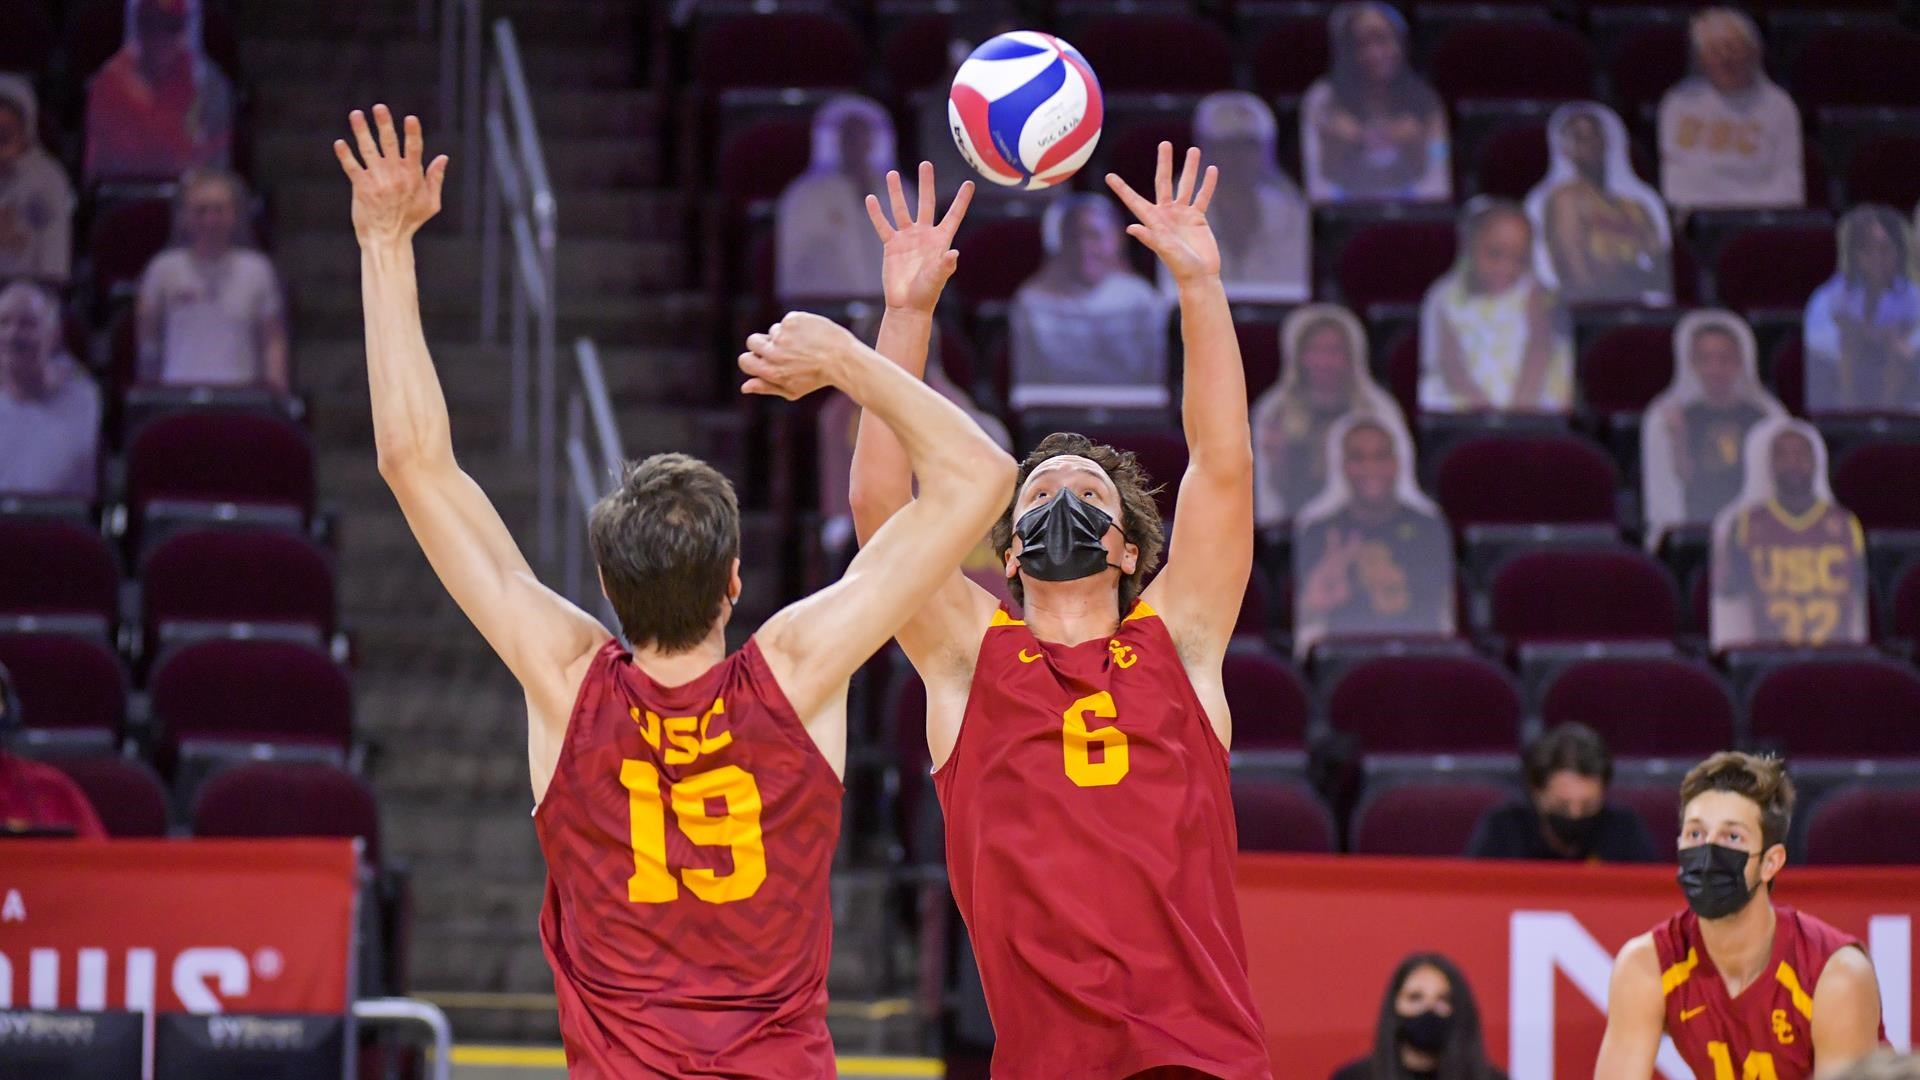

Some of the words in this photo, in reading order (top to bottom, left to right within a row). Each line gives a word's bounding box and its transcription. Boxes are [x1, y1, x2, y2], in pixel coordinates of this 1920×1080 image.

[630, 697, 733, 765] USC
[1063, 690, 1129, 787] 6
[619, 758, 768, 905] 19
